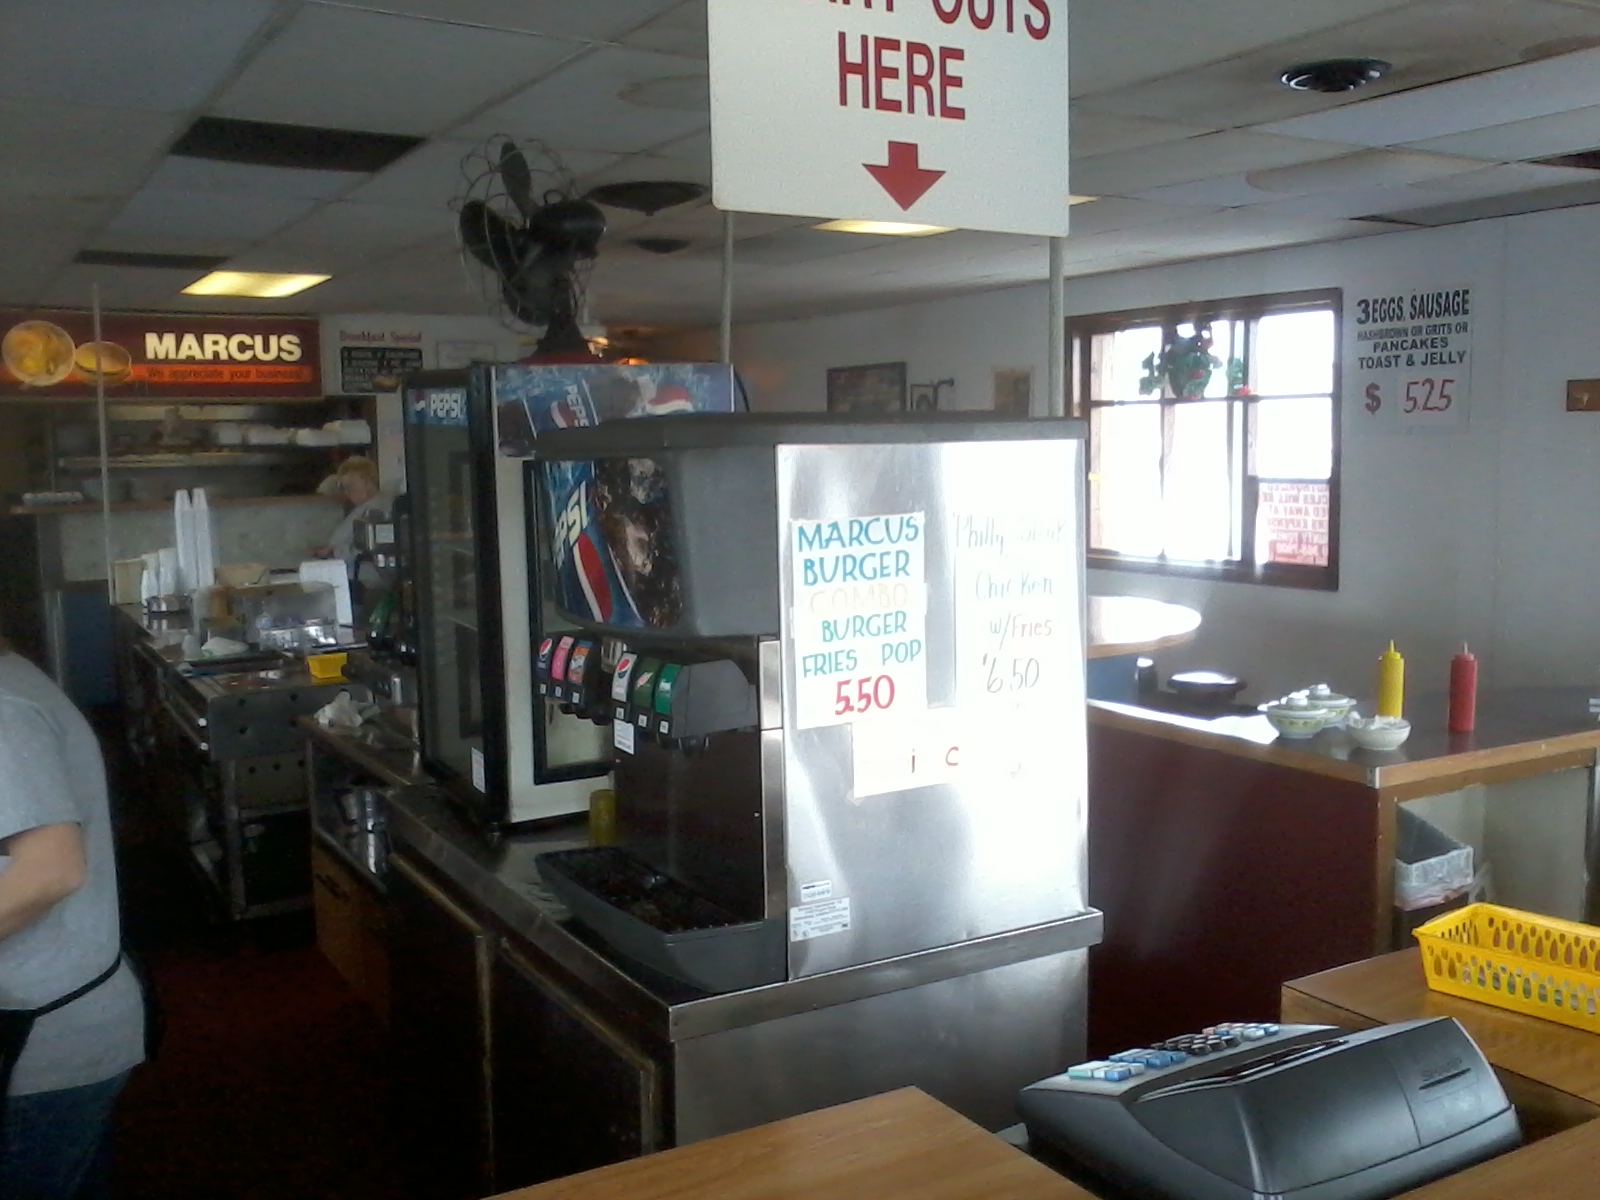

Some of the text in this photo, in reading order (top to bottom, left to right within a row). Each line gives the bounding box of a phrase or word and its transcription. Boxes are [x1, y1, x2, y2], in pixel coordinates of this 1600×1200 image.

[838, 31, 966, 120] HERE
[1409, 289, 1470, 320] SAUSAGE
[1373, 336, 1449, 353] PANCAKES
[1411, 325, 1423, 337] OR
[1425, 323, 1452, 335] GRITS
[1455, 322, 1468, 334] OR
[145, 332, 302, 362] MARCUS
[1358, 350, 1467, 369] TOAST & JELLY
[430, 393, 461, 419] PEPSI
[1365, 382, 1382, 416] $
[797, 515, 919, 552] MARCUS
[803, 549, 910, 586] BURGER
[810, 583, 909, 614] COMBO
[822, 610, 907, 643] BURGER
[802, 639, 922, 678] FRIES POP
